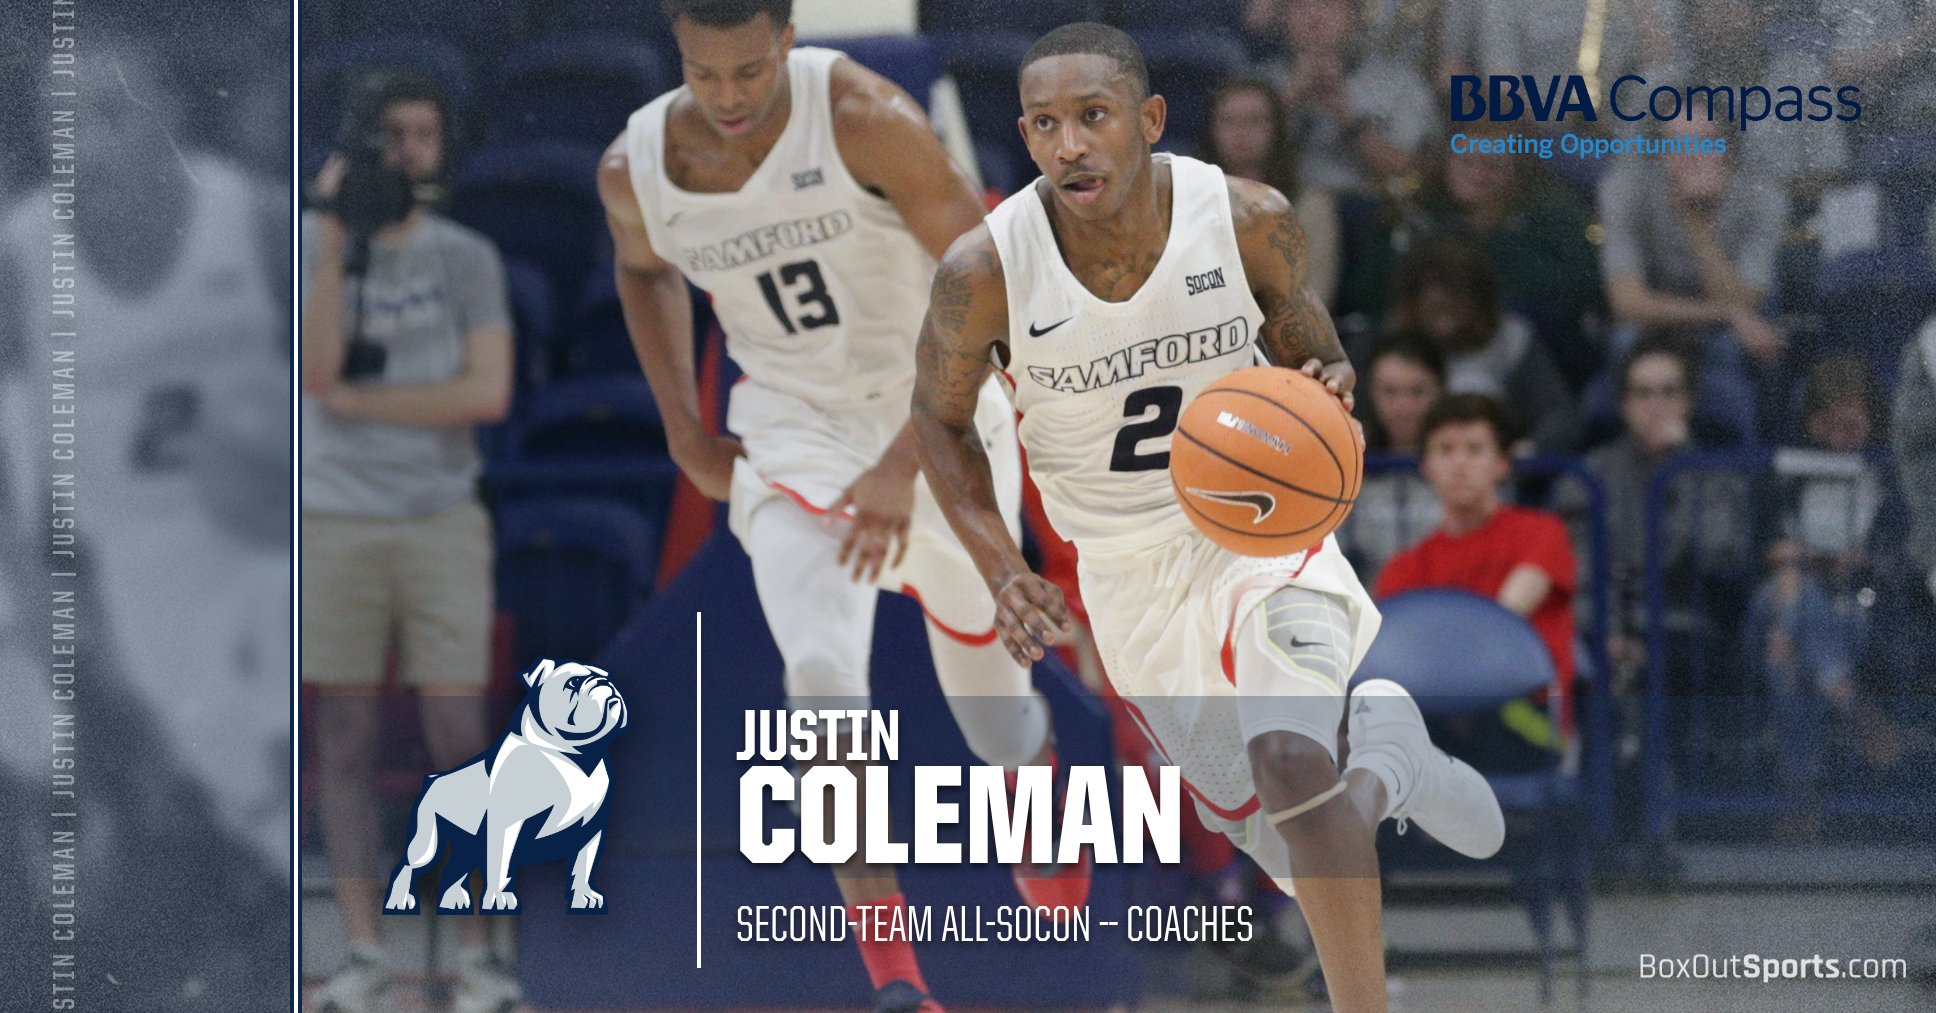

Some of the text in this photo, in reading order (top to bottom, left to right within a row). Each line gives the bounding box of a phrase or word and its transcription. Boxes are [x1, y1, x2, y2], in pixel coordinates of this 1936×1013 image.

[684, 209, 854, 272] SAMFORD
[756, 259, 841, 335] 13
[1185, 267, 1226, 296] SOCON
[1027, 316, 1249, 393] SAMFORD
[1109, 385, 1184, 472] 2
